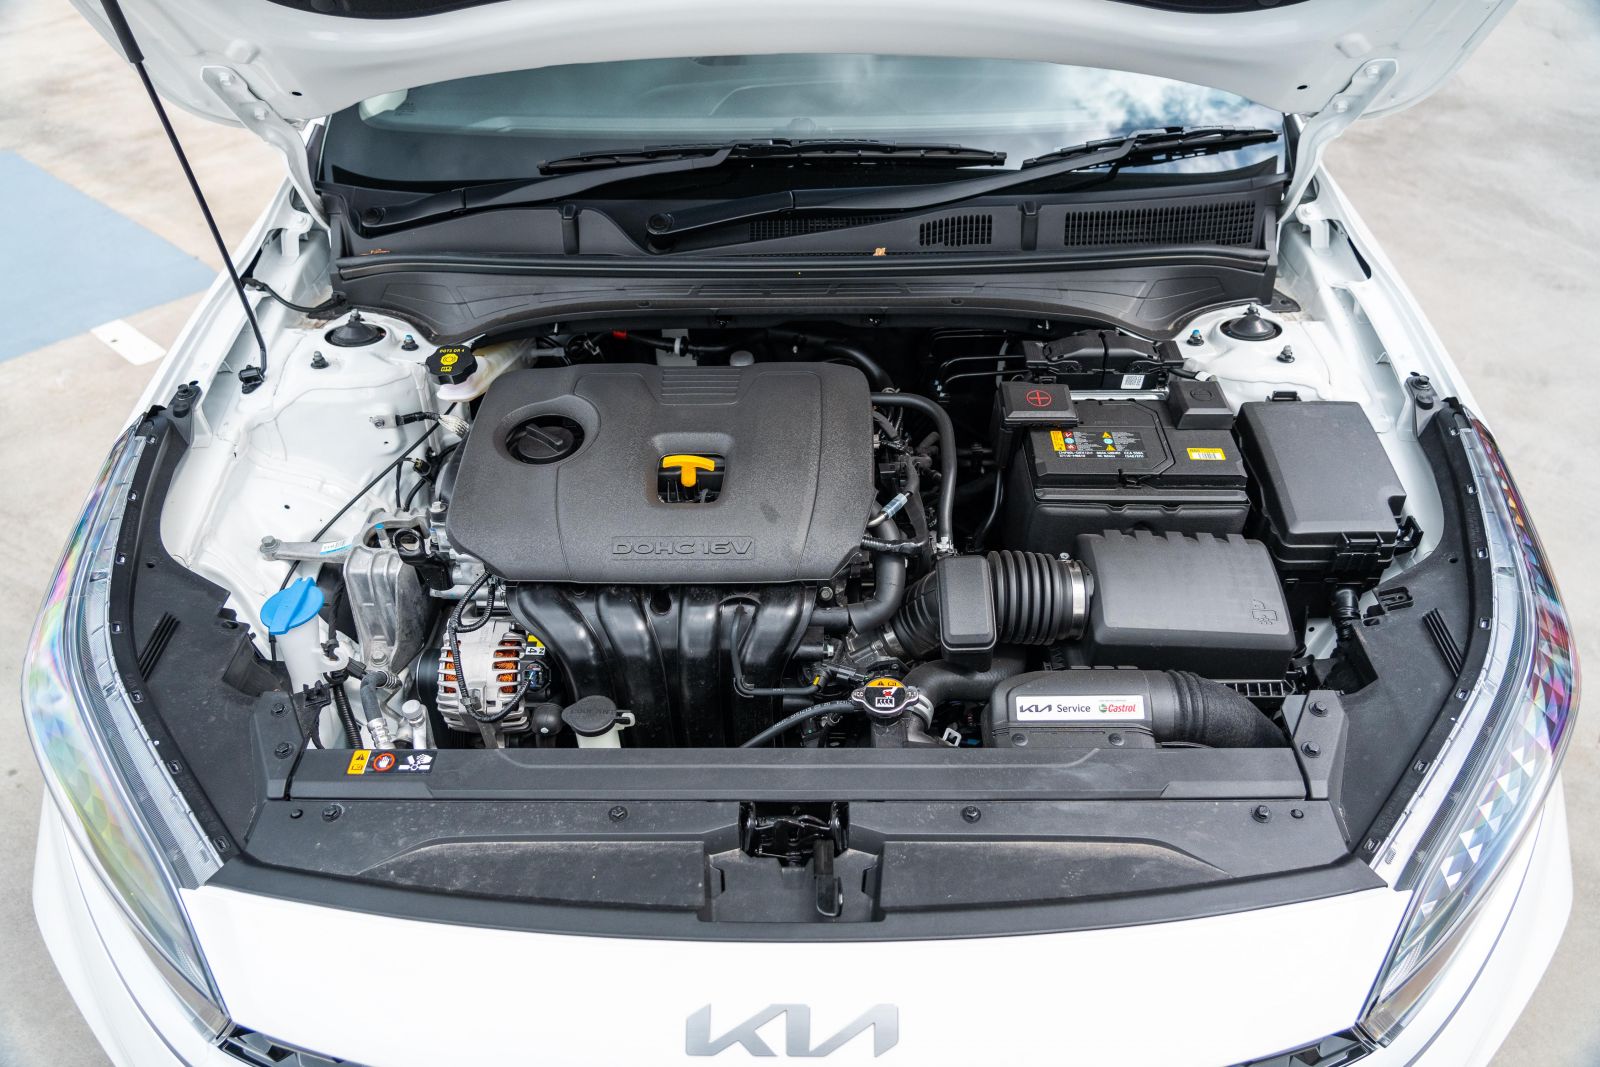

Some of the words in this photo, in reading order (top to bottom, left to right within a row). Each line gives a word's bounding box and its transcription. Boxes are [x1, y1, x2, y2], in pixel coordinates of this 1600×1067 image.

[612, 541, 695, 554] DOHC
[702, 541, 752, 554] 16V
[1019, 704, 1052, 712] KIA
[1056, 704, 1091, 712] Service
[1108, 703, 1136, 713] Castrol
[686, 1003, 899, 1058] KIA
